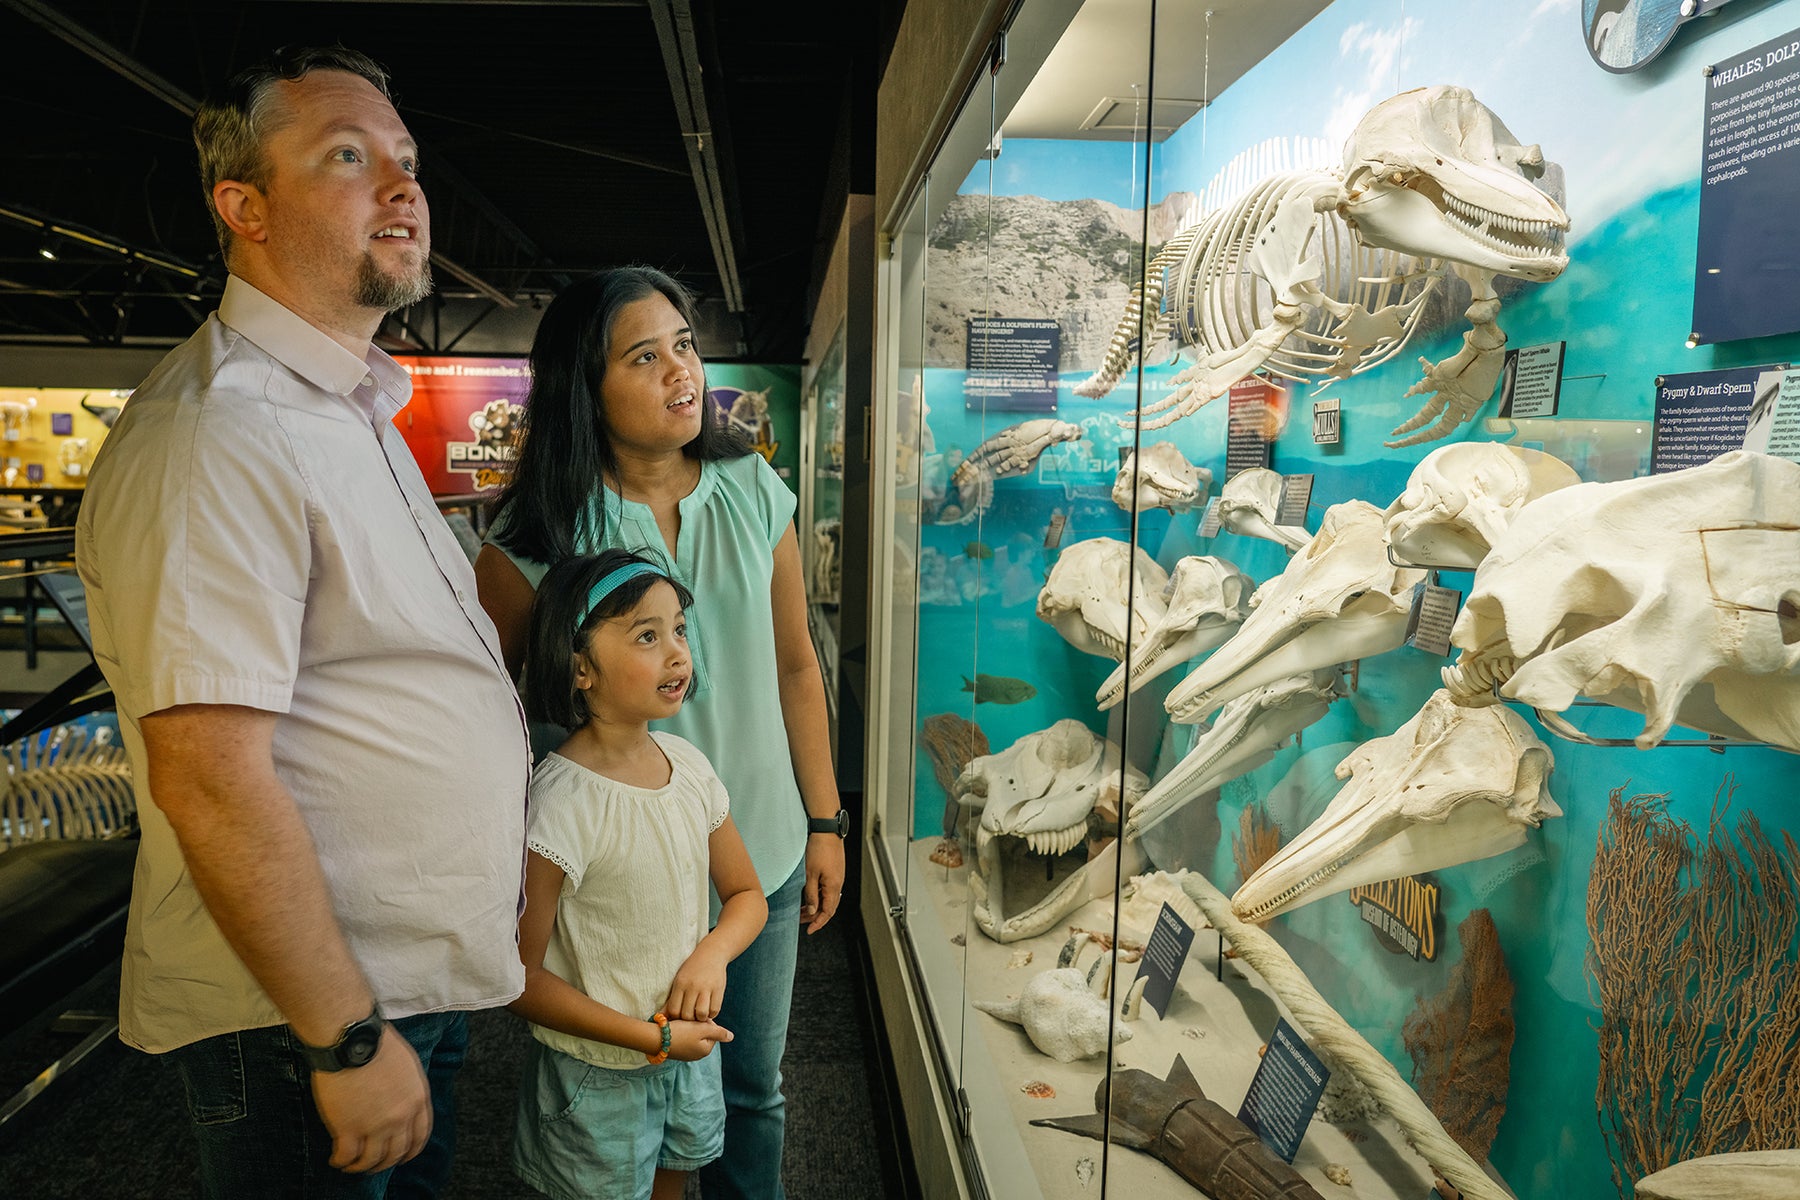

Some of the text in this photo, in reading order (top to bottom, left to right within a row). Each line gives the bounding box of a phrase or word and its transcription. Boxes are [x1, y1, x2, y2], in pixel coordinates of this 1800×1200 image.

[1713, 42, 1800, 88] WHALES, DOLP
[1710, 107, 1740, 125] porpoises
[1741, 94, 1775, 112] belonging
[1776, 91, 1784, 99] to
[1785, 86, 1796, 96] the
[1711, 72, 1800, 110] There are around 90 species
[1709, 140, 1714, 148] 4
[1714, 136, 1726, 146] feet
[1727, 133, 1734, 142] in
[1767, 119, 1778, 129] the
[1779, 111, 1800, 124] enorm
[1710, 128, 1716, 136] in
[1717, 124, 1728, 133] size
[1730, 118, 1744, 128] from
[1746, 113, 1757, 123] the
[1758, 109, 1771, 118] tiny
[1772, 100, 1793, 114] finless
[1708, 149, 1725, 160] reach
[1726, 141, 1750, 154] lengths
[1751, 138, 1757, 146] in
[1758, 131, 1780, 143] excess
[1781, 125, 1789, 137] of
[1708, 158, 1740, 172] carnivores,
[1741, 149, 1766, 162] feeding
[1767, 145, 1776, 154] on
[1783, 137, 1800, 149] varie
[1707, 166, 1748, 185] cephalopods.
[415, 366, 432, 375] me
[433, 365, 455, 375] and
[456, 365, 462, 376] I
[1785, 375, 1800, 383] Pygm
[1662, 386, 1689, 399] Pygmy
[1690, 386, 1696, 396] &
[1697, 382, 1722, 396] Dwarf
[1723, 383, 1751, 396] Sperm
[1669, 407, 1682, 416] family
